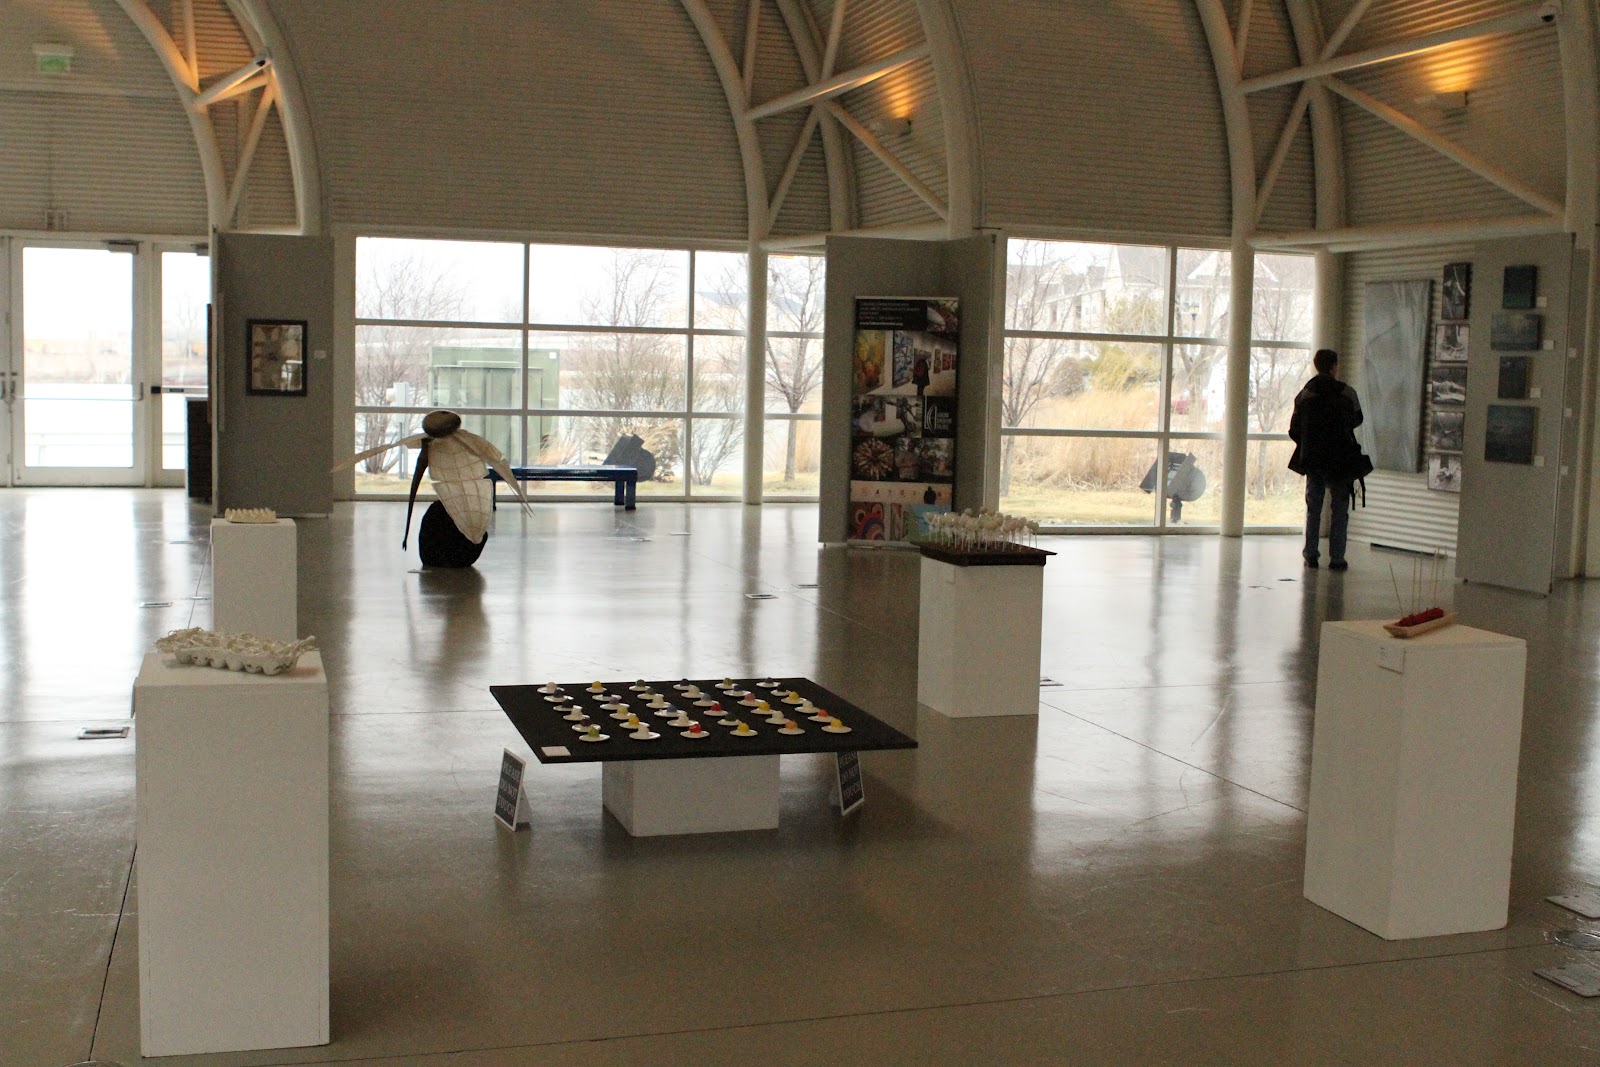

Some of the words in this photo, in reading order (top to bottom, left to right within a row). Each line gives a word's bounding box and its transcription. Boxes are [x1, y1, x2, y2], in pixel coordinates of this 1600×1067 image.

[502, 761, 520, 782] PLEASE
[507, 782, 518, 800] NOT
[497, 795, 515, 817] TOUCH
